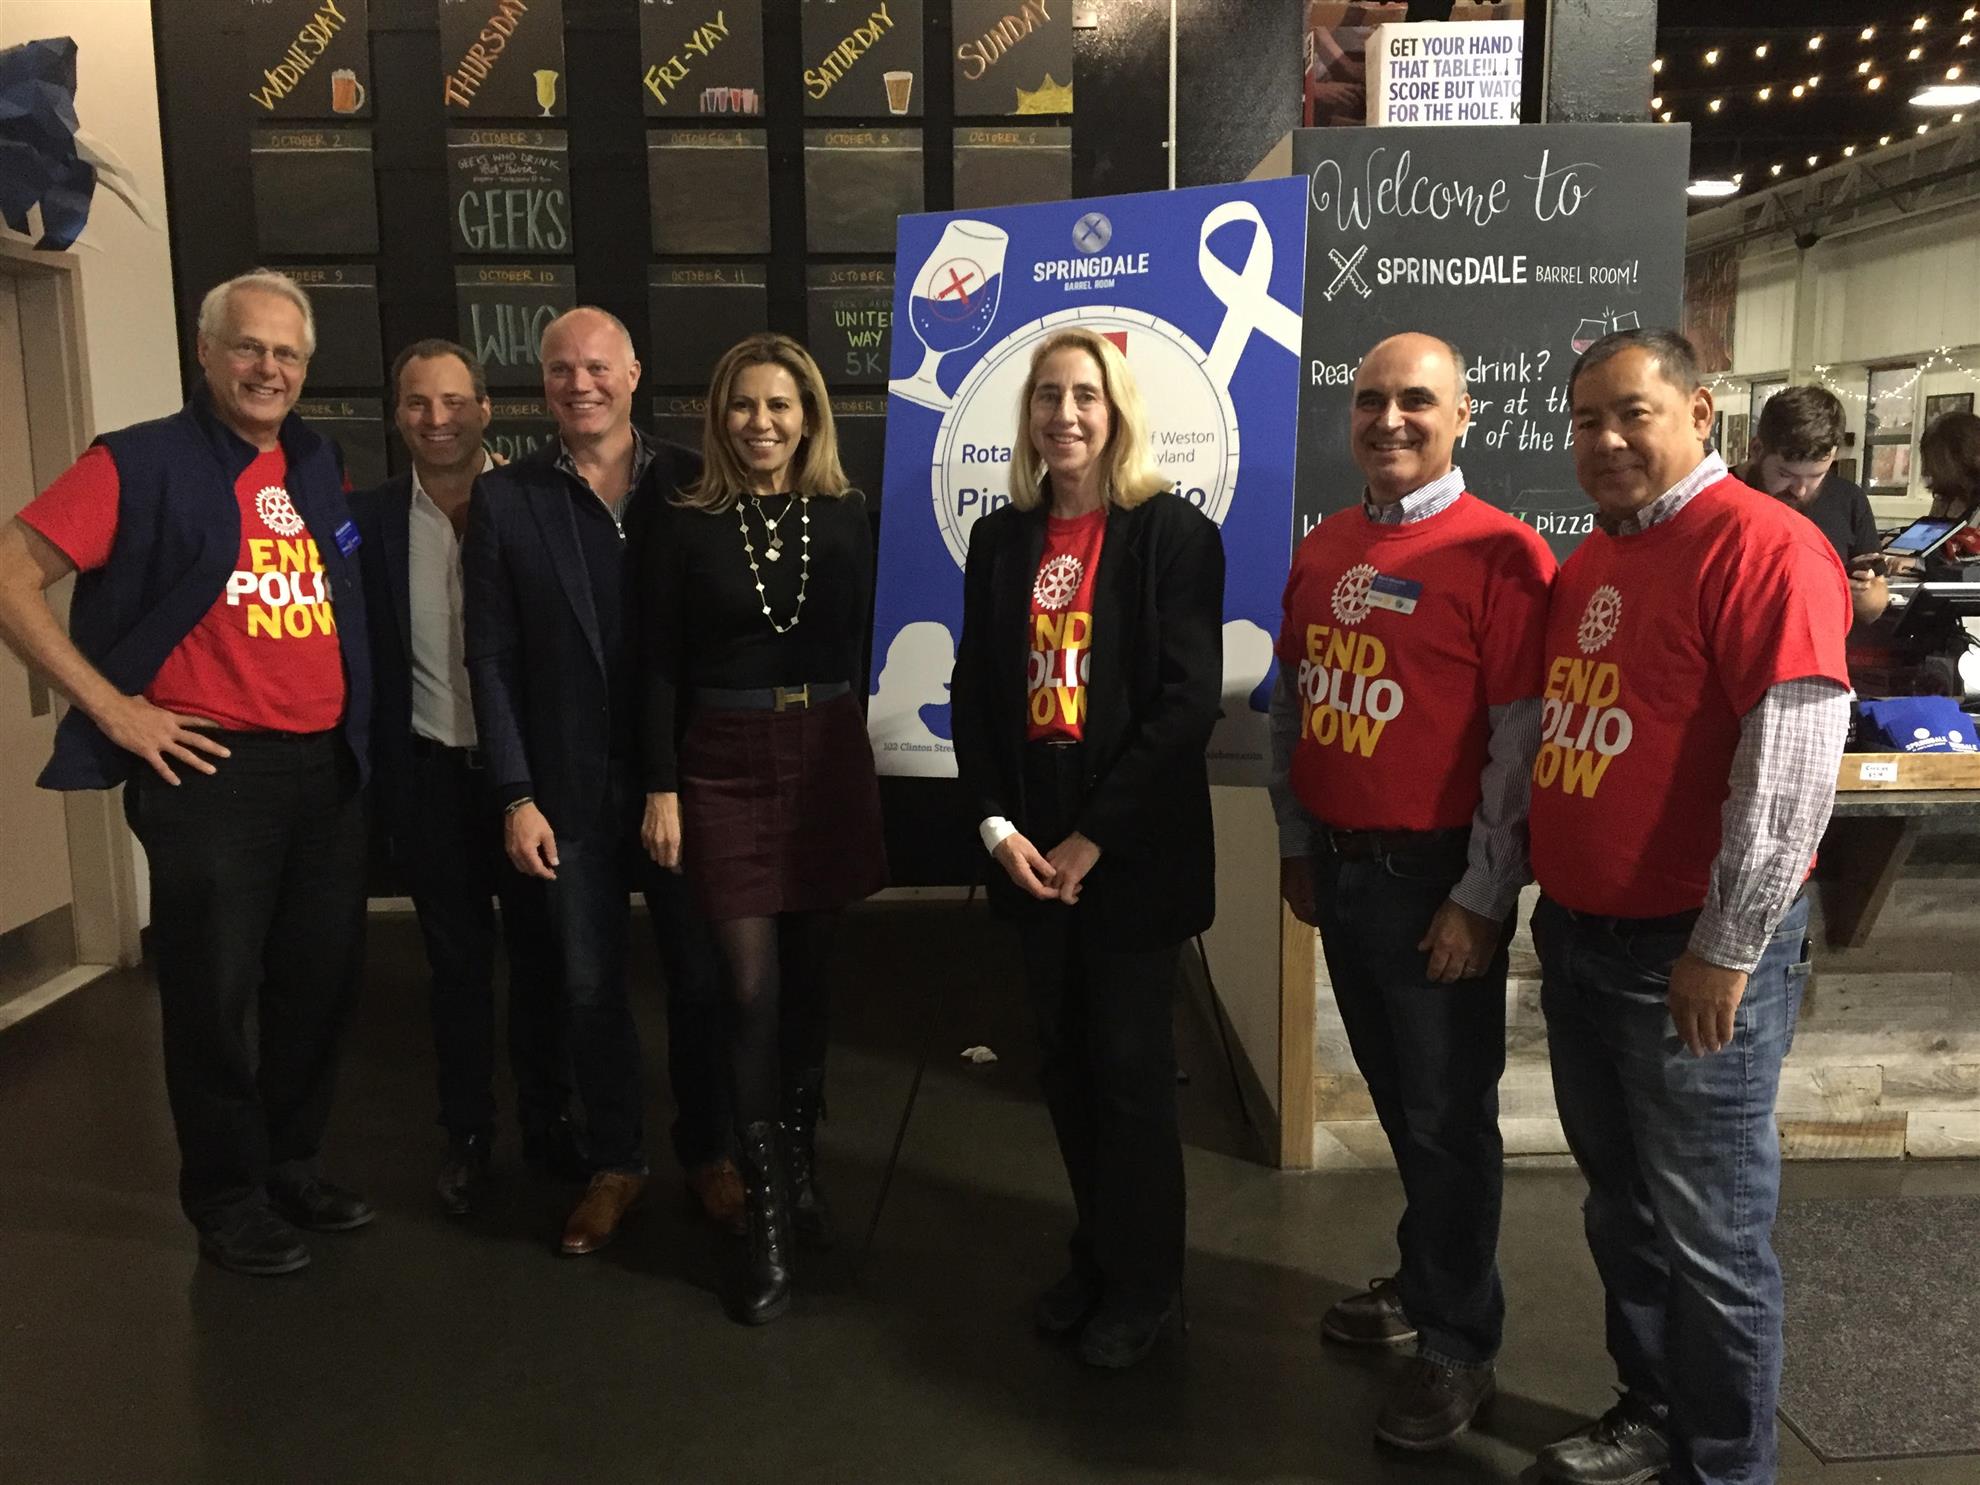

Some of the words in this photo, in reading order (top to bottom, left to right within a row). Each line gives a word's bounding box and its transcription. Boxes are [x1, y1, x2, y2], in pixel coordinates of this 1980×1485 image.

[249, 0, 346, 110] WEDNESDAY
[643, 10, 729, 106] FRI-YAY
[803, 1, 894, 99] SATURDAY
[1390, 38, 1418, 57] GET
[1422, 37, 1464, 56] YOUR
[1469, 36, 1513, 55] HAND
[1389, 60, 1429, 79] THAT
[1389, 82, 1439, 101] SCORE
[1445, 80, 1475, 99] BUT
[1480, 79, 1521, 98] WATC
[1388, 104, 1419, 122] FOR
[1424, 103, 1453, 121] THE
[1459, 102, 1504, 120] HOLE.
[271, 132, 328, 148] OCTOBER
[471, 132, 529, 145] OCTOBER
[671, 132, 728, 145] OCTOBER
[825, 133, 876, 145] OCTOBER
[969, 132, 1020, 144] OCTOBER
[1312, 147, 1511, 231] Welcome
[1524, 149, 1602, 222] to
[458, 188, 567, 250] GEEKS
[480, 270, 535, 281] OCTOBER
[671, 271, 726, 284] OCTOBER
[830, 271, 885, 282] OCTOBER
[1033, 252, 1150, 282] SPRINGDALE
[1377, 255, 1528, 286] SPRINGDALE
[1535, 264, 1584, 285] BARREL
[1589, 260, 1639, 285] ROOM!
[1064, 281, 1092, 292] BARREL
[1094, 278, 1115, 290] ROOM
[835, 311, 893, 327] UNITE
[847, 330, 883, 348] WAY
[1466, 350, 1551, 384] drink?
[493, 404, 543, 416] CTOBER
[1503, 388, 1528, 416] at
[962, 444, 1011, 464] Rota
[1160, 431, 1215, 445] Weston
[1486, 419, 1514, 450] of
[1518, 419, 1554, 451] the
[1156, 448, 1195, 467] yland
[1536, 511, 1594, 535] pizza
[226, 570, 333, 607] POLI
[1030, 611, 1093, 651] ND
[1306, 623, 1386, 677] END
[1298, 658, 1404, 722] POLIO
[1544, 656, 1620, 708] END
[1030, 686, 1088, 726] OW
[1542, 697, 1633, 756] OLIO
[900, 742, 933, 753] Clinton
[1533, 742, 1614, 798] OW
